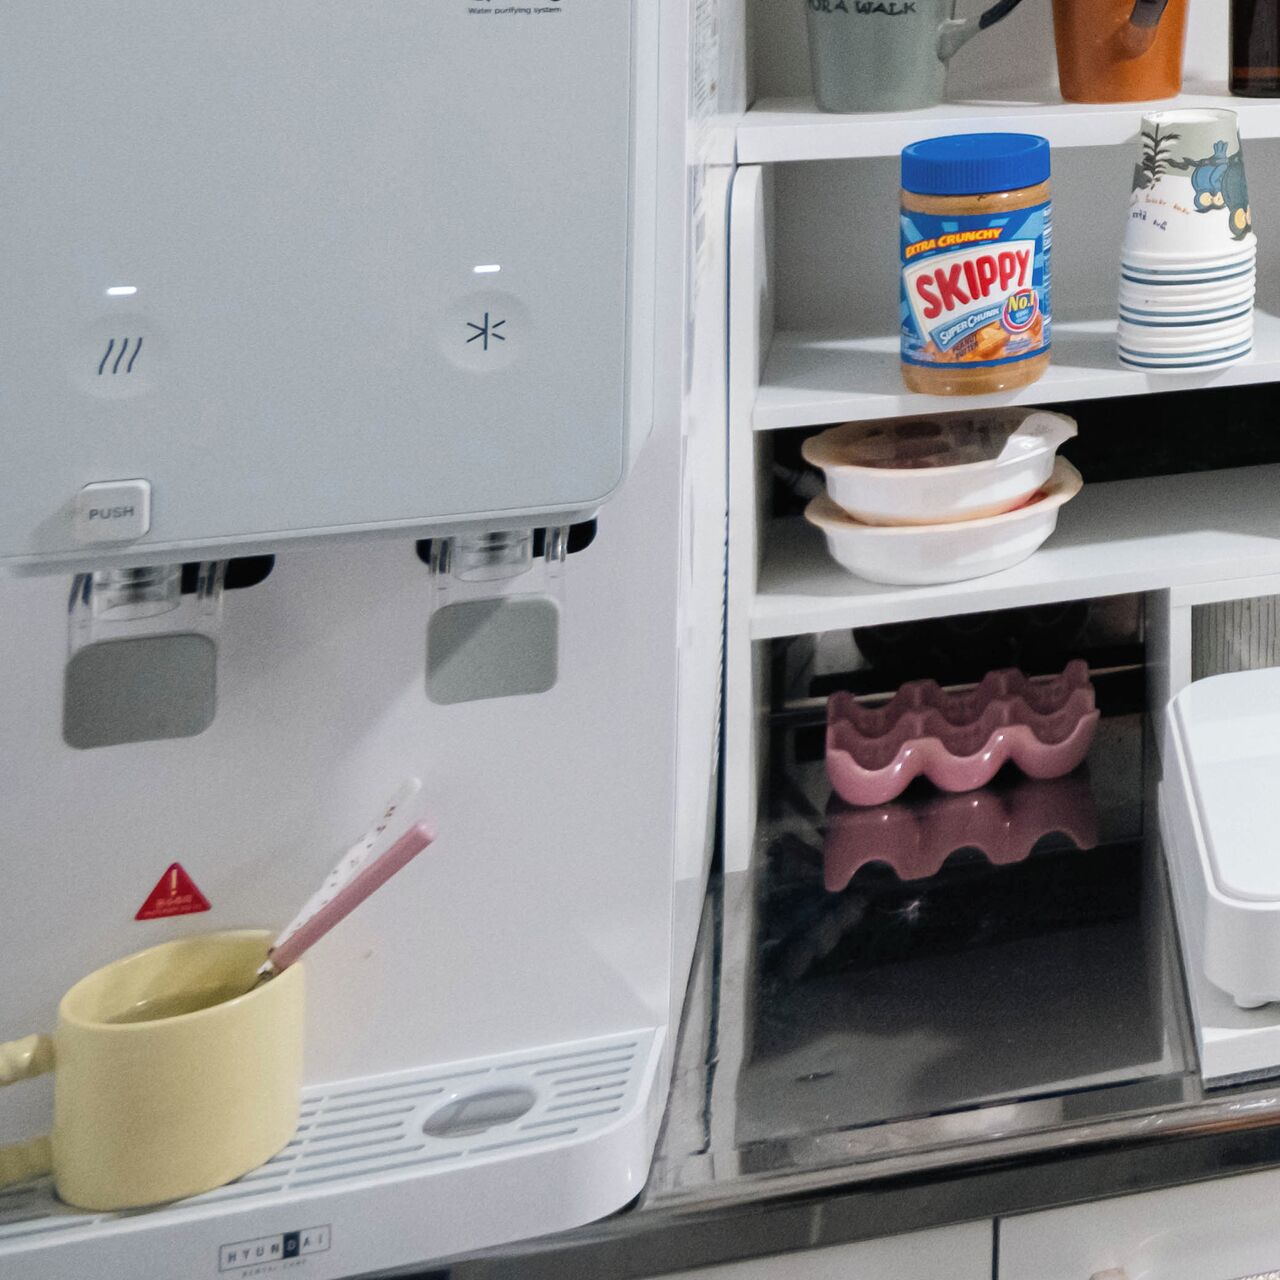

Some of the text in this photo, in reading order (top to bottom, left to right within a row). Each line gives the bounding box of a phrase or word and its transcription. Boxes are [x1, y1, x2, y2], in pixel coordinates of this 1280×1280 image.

[834, 0, 848, 13] A
[855, 1, 917, 16] WALK
[905, 228, 1003, 259] EXTRA CRUNCHY
[916, 248, 1030, 319] SKIPPY
[939, 320, 967, 345] SUPER
[967, 307, 1001, 328] CHUNK
[89, 506, 134, 520] PUSH
[228, 1234, 323, 1263] HYUNDAI
